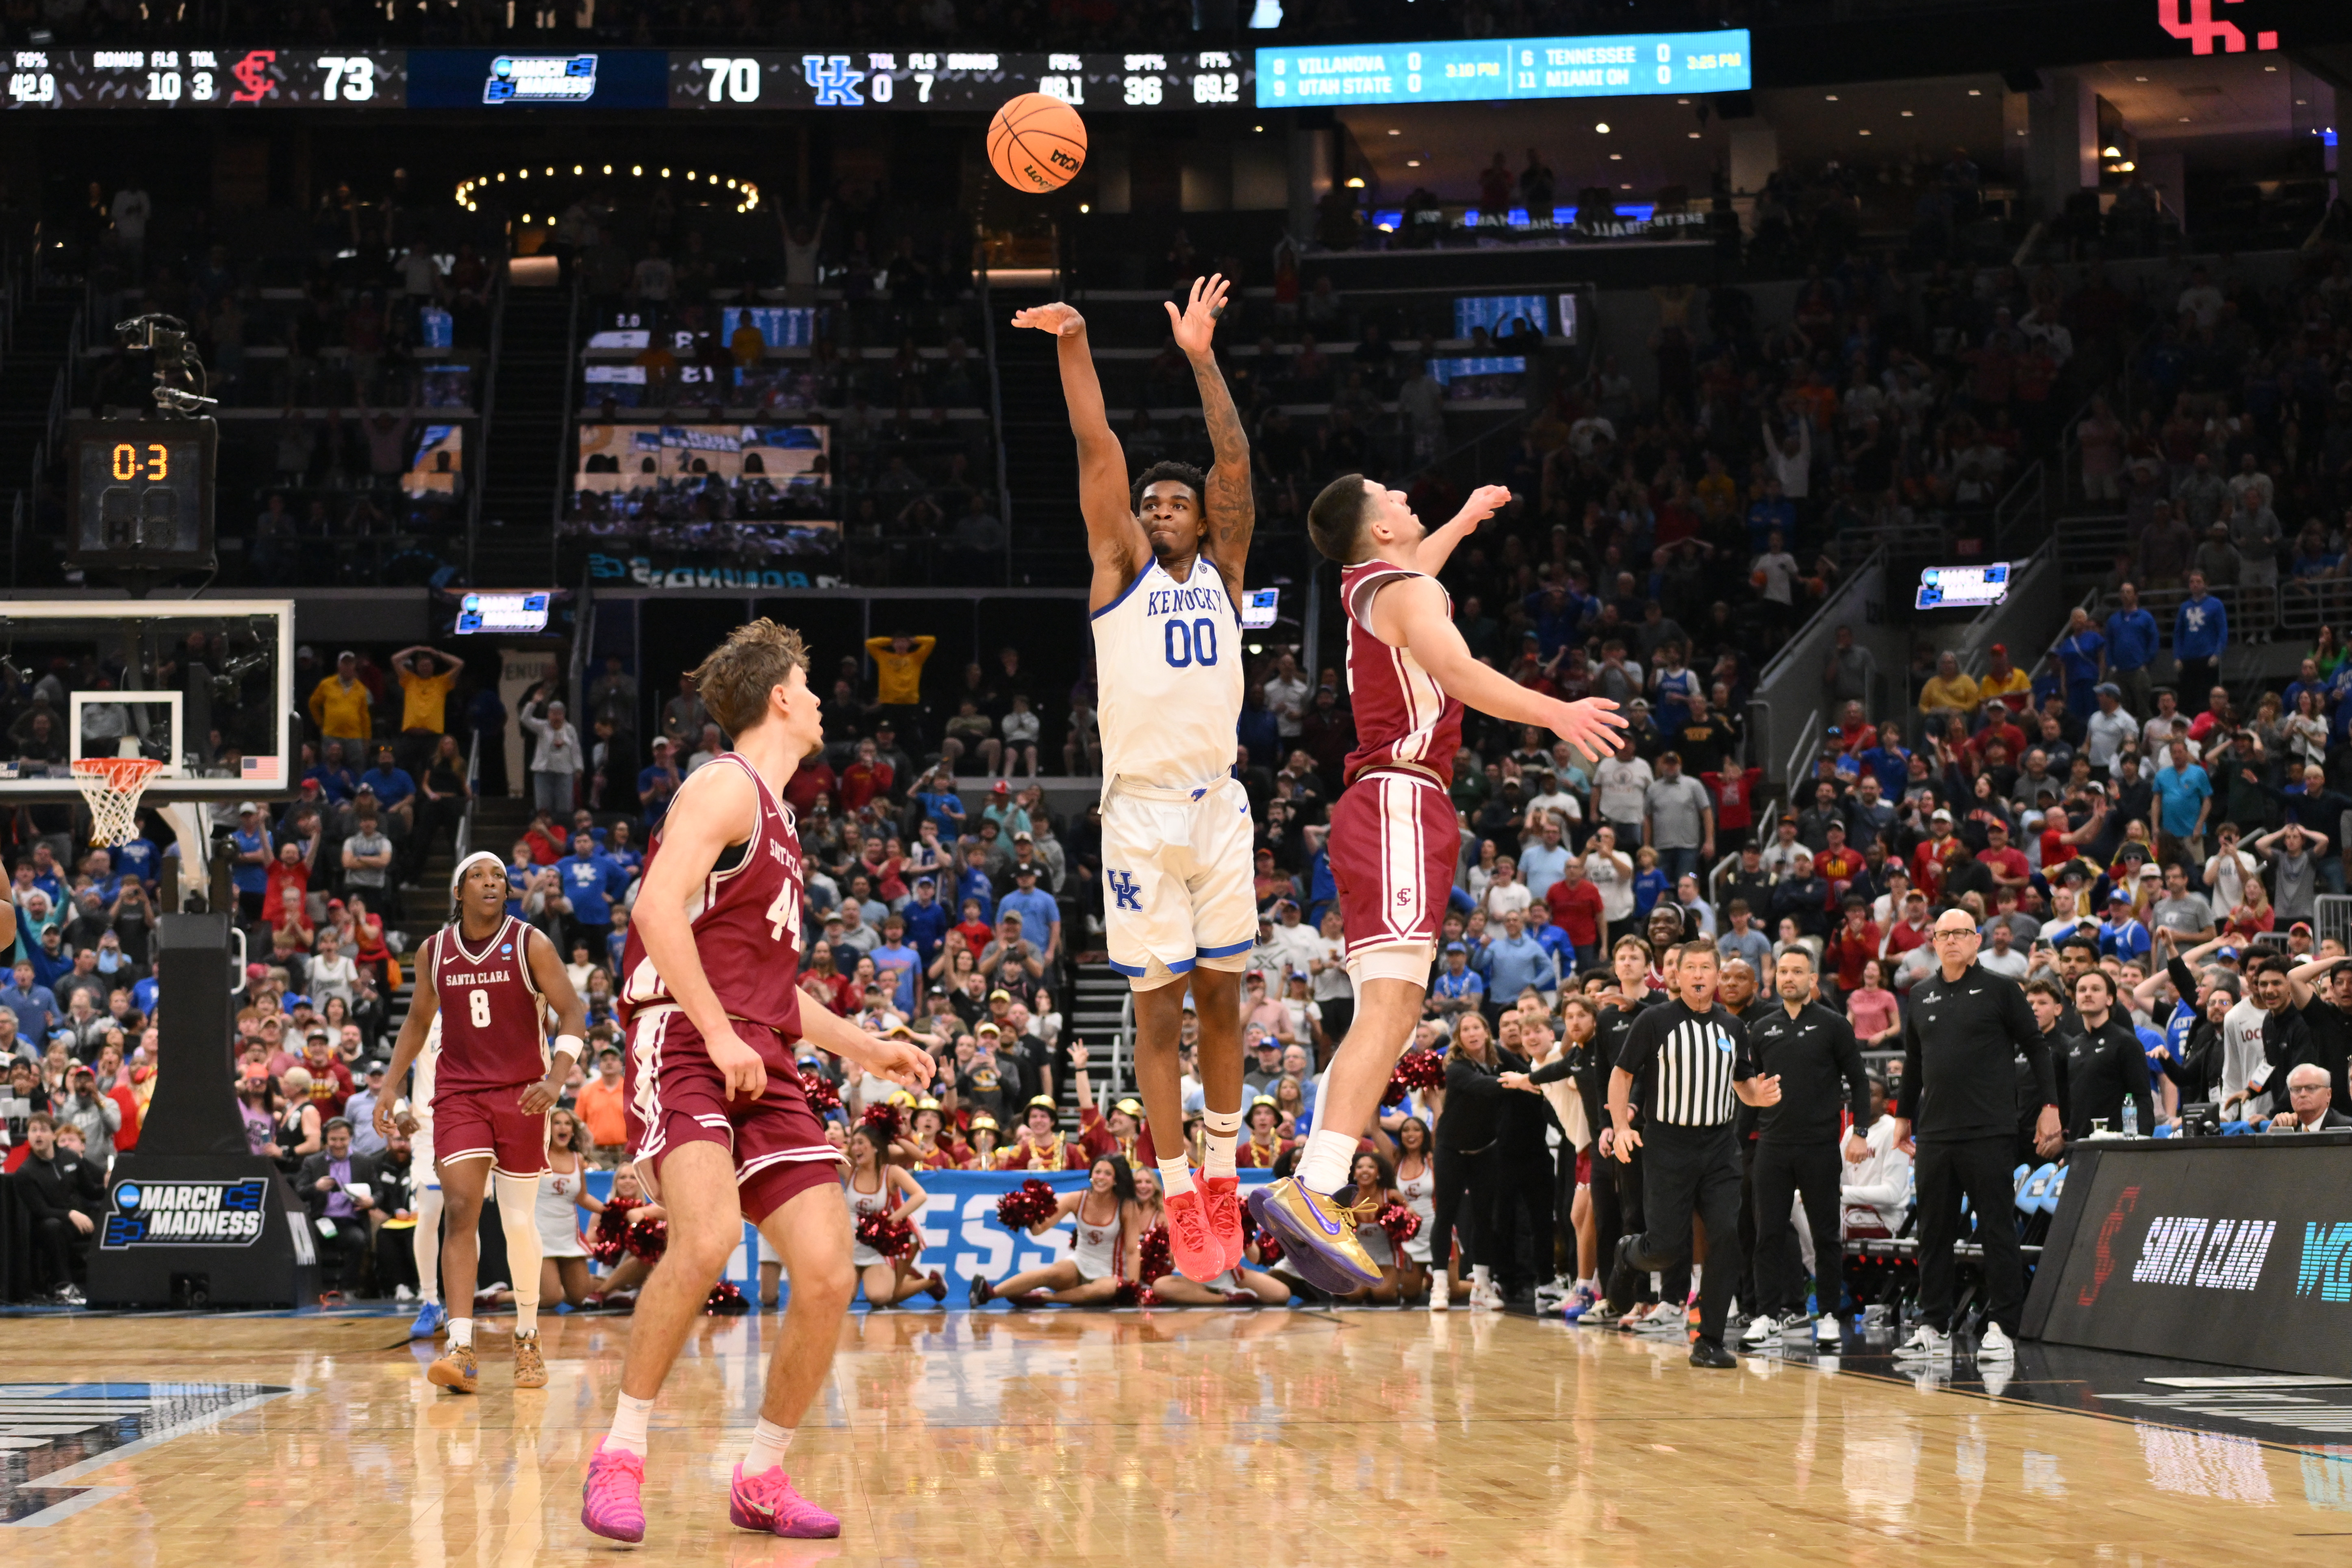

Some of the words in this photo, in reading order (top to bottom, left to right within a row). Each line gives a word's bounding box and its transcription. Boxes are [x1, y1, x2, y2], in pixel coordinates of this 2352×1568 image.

[16, 52, 48, 68] FG%
[93, 52, 143, 68] BONUS
[151, 52, 178, 67] FLS
[189, 52, 215, 67] TOL
[869, 53, 896, 69] TOL
[909, 54, 937, 69] FLS
[947, 54, 998, 70] BONUS
[1049, 54, 1082, 70] FG%
[1124, 54, 1166, 70] 3PT%
[1200, 52, 1231, 68] FT%
[1274, 59, 1285, 75] 8
[1297, 56, 1386, 74] VILLANOVA
[1408, 52, 1421, 71] 0
[1521, 50, 1533, 66] 6
[1546, 46, 1636, 65] TENNESSEE
[1657, 43, 1670, 62] 0
[1687, 55, 1716, 69] 3:25
[1719, 53, 1741, 67] PM
[317, 58, 373, 100] 73
[512, 60, 567, 77] MARCH
[702, 58, 759, 102] 70
[802, 55, 864, 105] UK
[1446, 63, 1475, 78] 3:10
[1478, 62, 1499, 76] PM
[1518, 72, 1537, 88] 11
[1546, 69, 1603, 87] MIAMI
[1606, 68, 1629, 85] OH
[1657, 65, 1670, 84] 0
[9, 73, 54, 102] 42.9
[146, 72, 180, 101] 10
[193, 73, 212, 100] 3
[516, 76, 592, 94] MADNESS
[872, 75, 893, 102] 0
[914, 75, 933, 102] 7
[1039, 76, 1084, 105] 48.1
[1124, 76, 1162, 105] 36
[1194, 74, 1239, 104] 69.2
[1274, 80, 1285, 97] 9
[1299, 79, 1340, 96] UTAH
[1343, 76, 1392, 94] STATE
[1408, 74, 1421, 93] 0
[1050, 149, 1081, 173] NCAA
[113, 443, 167, 481] 0.3
[1165, 618, 1217, 668] 00
[1106, 867, 1144, 912] UK
[766, 877, 801, 953] 44
[446, 974, 476, 987] SANTA
[478, 970, 510, 984] CLARA
[469, 989, 491, 1028] 8
[139, 1186, 223, 1211] MARCH
[148, 1210, 261, 1236] MADNESS
[2133, 1217, 2209, 1286] SANTA
[2195, 1219, 2276, 1291] CLARA
